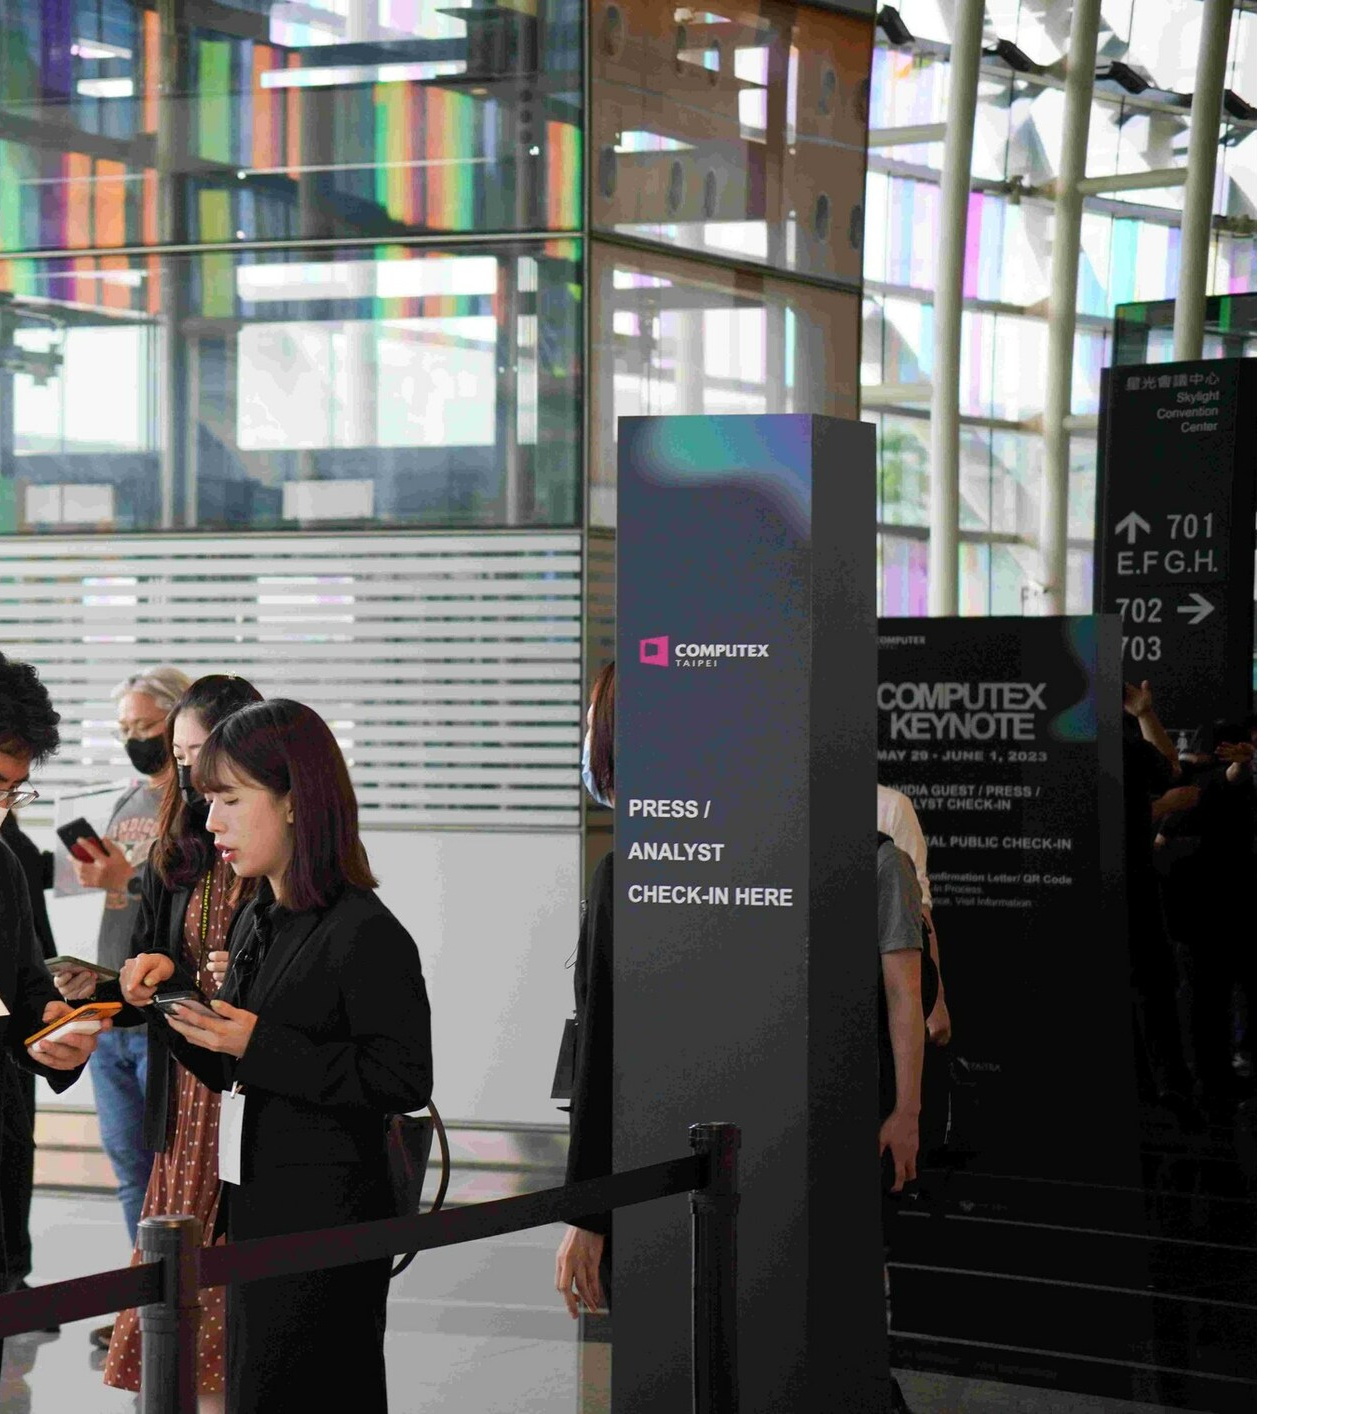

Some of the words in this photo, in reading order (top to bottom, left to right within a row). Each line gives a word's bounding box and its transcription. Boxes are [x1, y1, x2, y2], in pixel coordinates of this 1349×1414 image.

[1177, 391, 1220, 404] Skylight
[1157, 405, 1218, 419] Convention
[1181, 421, 1218, 433] Center
[1166, 512, 1212, 540] 701
[1115, 597, 1162, 623] 702
[877, 636, 926, 645] OMPUTEX
[675, 643, 769, 658] COMPUTEX
[675, 659, 717, 667] TAIPEI
[876, 682, 1047, 710] COMPUTEX
[890, 711, 1035, 740] KEYNOTE
[877, 750, 906, 760] MAY
[942, 750, 984, 761] JUNE
[1007, 751, 1047, 762] 2023
[888, 784, 928, 796] VIDIA
[931, 784, 975, 797] GUEST
[986, 785, 1032, 797] PRESS
[628, 799, 698, 818] PRESS
[913, 798, 944, 810] LYST
[947, 798, 1011, 811] CHECK-IN
[950, 836, 999, 848] PUBLIC
[1002, 837, 1071, 850] CHECK-IN
[628, 842, 724, 861] ANALYST
[929, 871, 985, 882] onfirmation
[1043, 874, 1072, 885] Code
[628, 885, 729, 905] CHECK-IN
[735, 887, 793, 907] HERE
